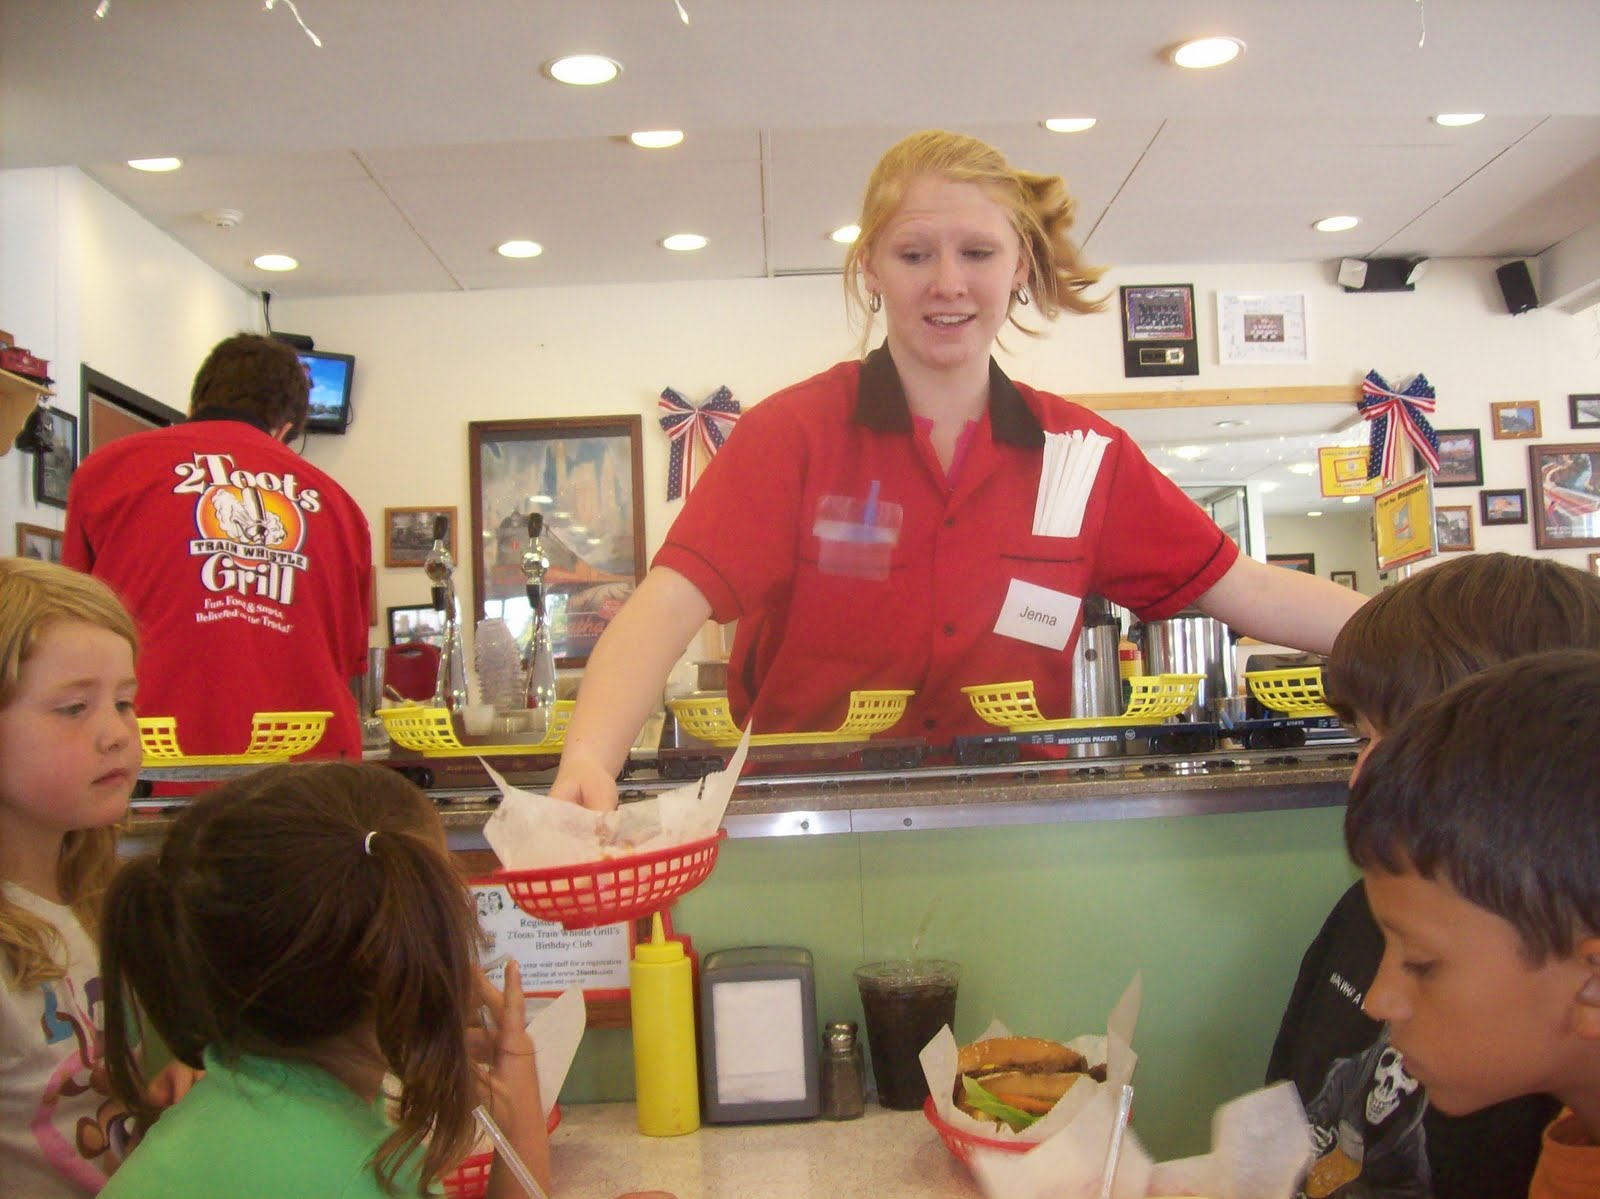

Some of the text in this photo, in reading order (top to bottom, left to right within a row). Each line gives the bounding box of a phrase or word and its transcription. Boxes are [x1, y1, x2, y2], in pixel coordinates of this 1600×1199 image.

[173, 452, 321, 513] 2Toots
[194, 541, 304, 566] TRAIN WHISTLE
[201, 553, 294, 604] Grill
[246, 602, 256, 613] &
[196, 609, 238, 622] Delivered
[1020, 606, 1057, 626] Jenna
[537, 929, 558, 939] Train
[560, 927, 592, 938] Whistle
[593, 927, 620, 936] Grill's
[536, 940, 593, 951] Birthday Club
[554, 960, 568, 968] staff
[586, 959, 622, 967] registration
